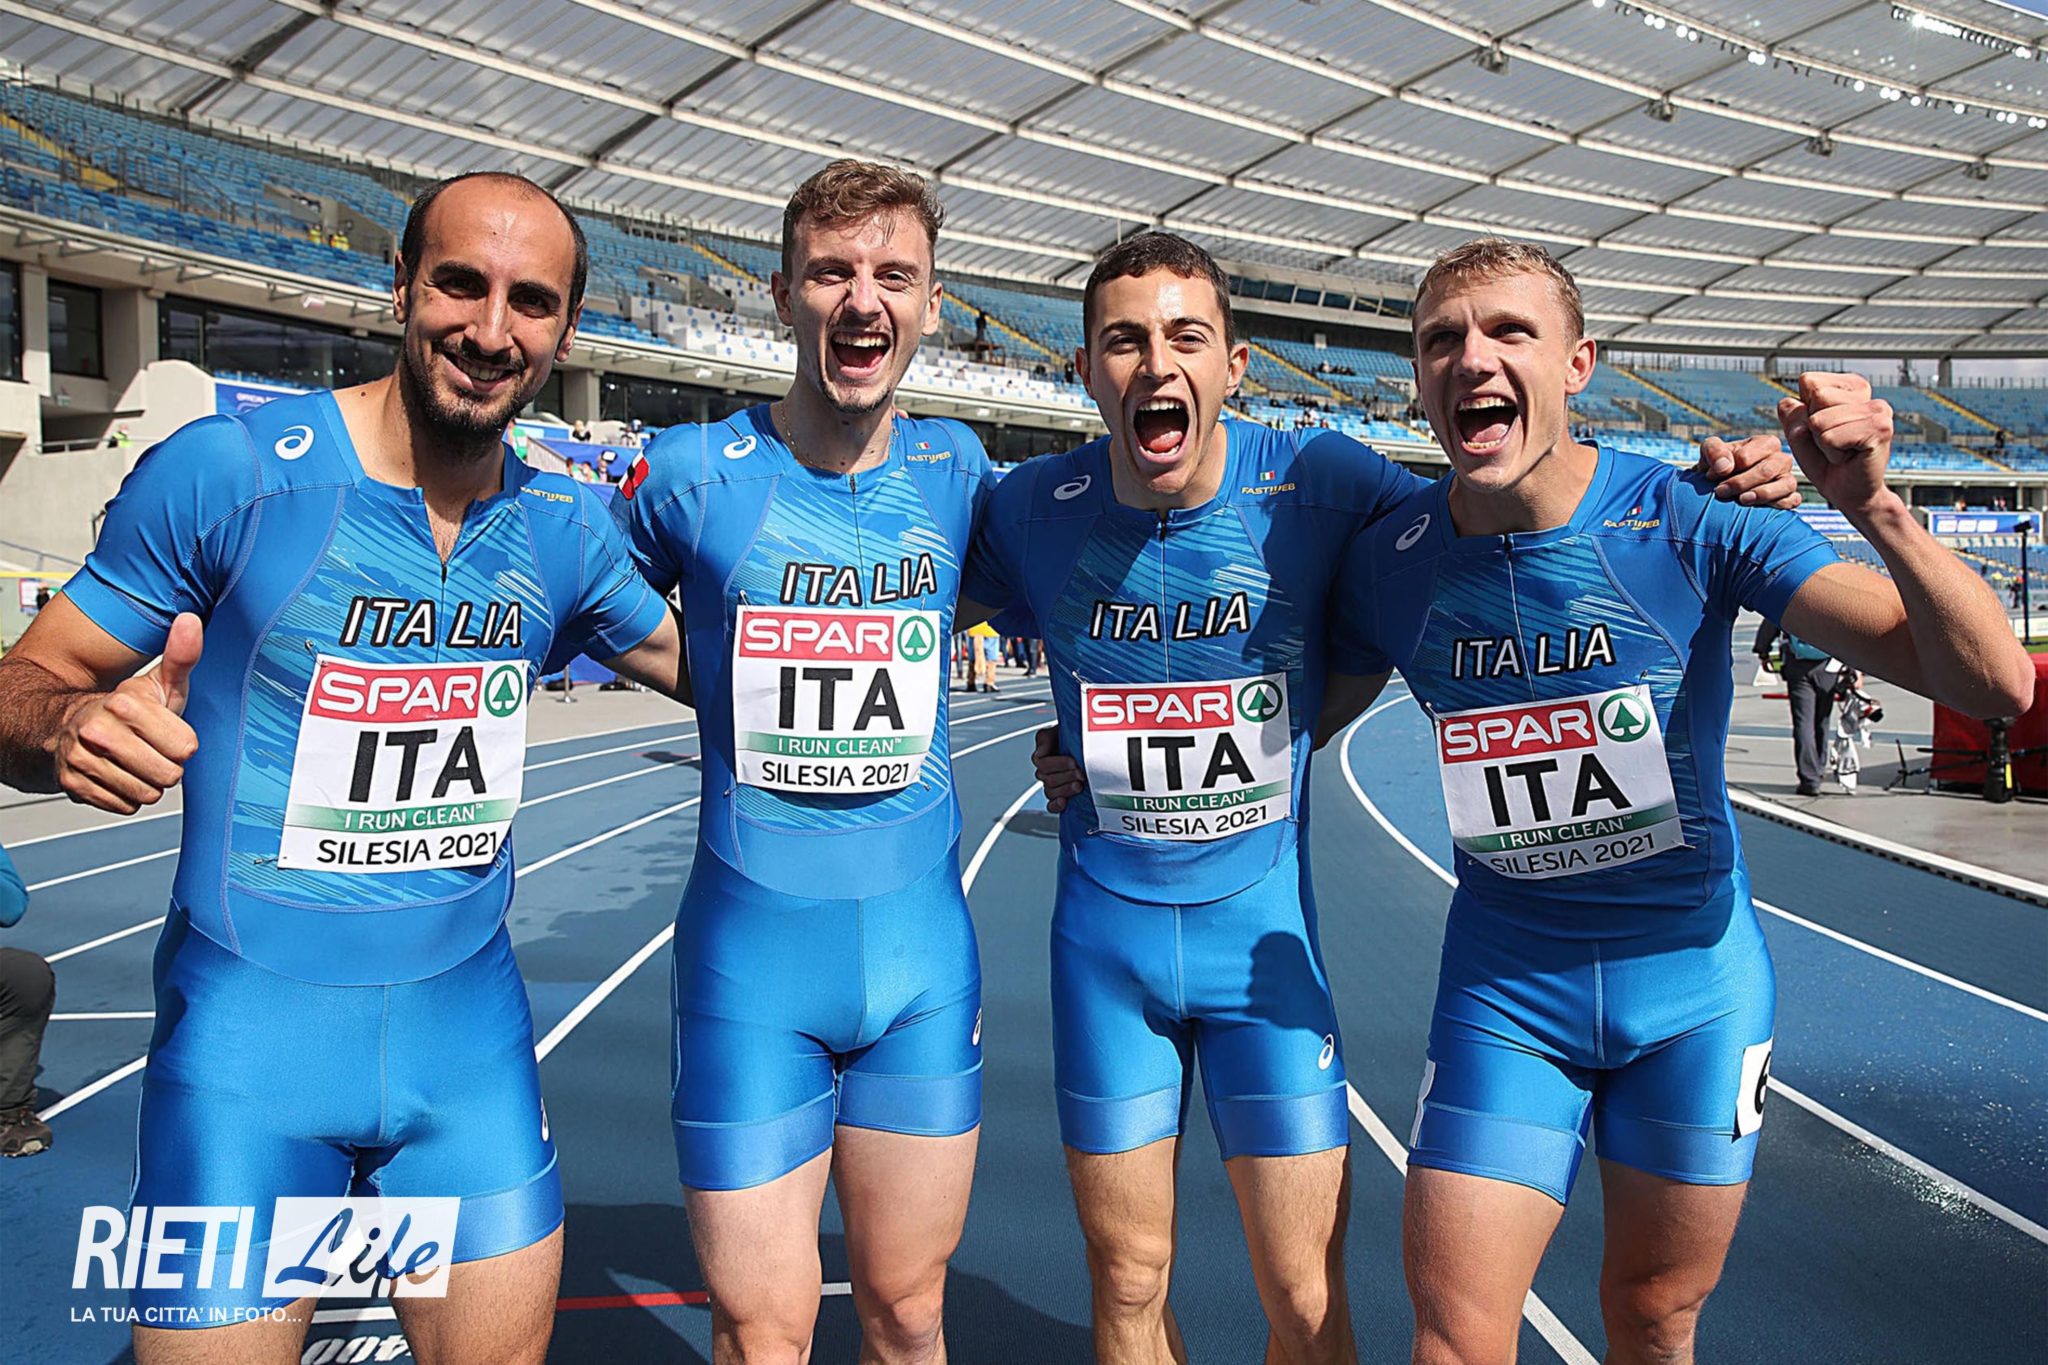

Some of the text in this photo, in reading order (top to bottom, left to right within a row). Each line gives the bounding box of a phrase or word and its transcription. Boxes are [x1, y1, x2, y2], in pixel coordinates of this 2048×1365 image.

[1242, 483, 1295, 495] FASTWEB
[780, 553, 937, 604] ITALIA
[340, 596, 522, 648] ITALIA
[744, 619, 890, 655] SPAR
[1089, 592, 1251, 642] ITALIA
[1452, 623, 1616, 679] ITALIA
[317, 671, 478, 716] SPAR
[779, 667, 904, 731] ITA
[1091, 693, 1230, 725] SPAR
[778, 739, 783, 751] I
[787, 739, 830, 753] RUN
[1444, 708, 1592, 756] SPAR
[348, 726, 487, 802] ITA
[762, 762, 909, 786] SILESIA 2021
[1127, 733, 1256, 791] ITA
[1133, 797, 1138, 810] I
[1142, 796, 1181, 810] RUN
[1484, 753, 1631, 827] ITA
[345, 815, 352, 829] I
[358, 811, 406, 828] RUN
[1122, 806, 1267, 835] SILESIA 2021
[1500, 834, 1506, 848] I
[1511, 829, 1552, 847] RUN
[317, 831, 498, 865] SILESIA 2021
[1491, 833, 1654, 874] SILESIA 2021
